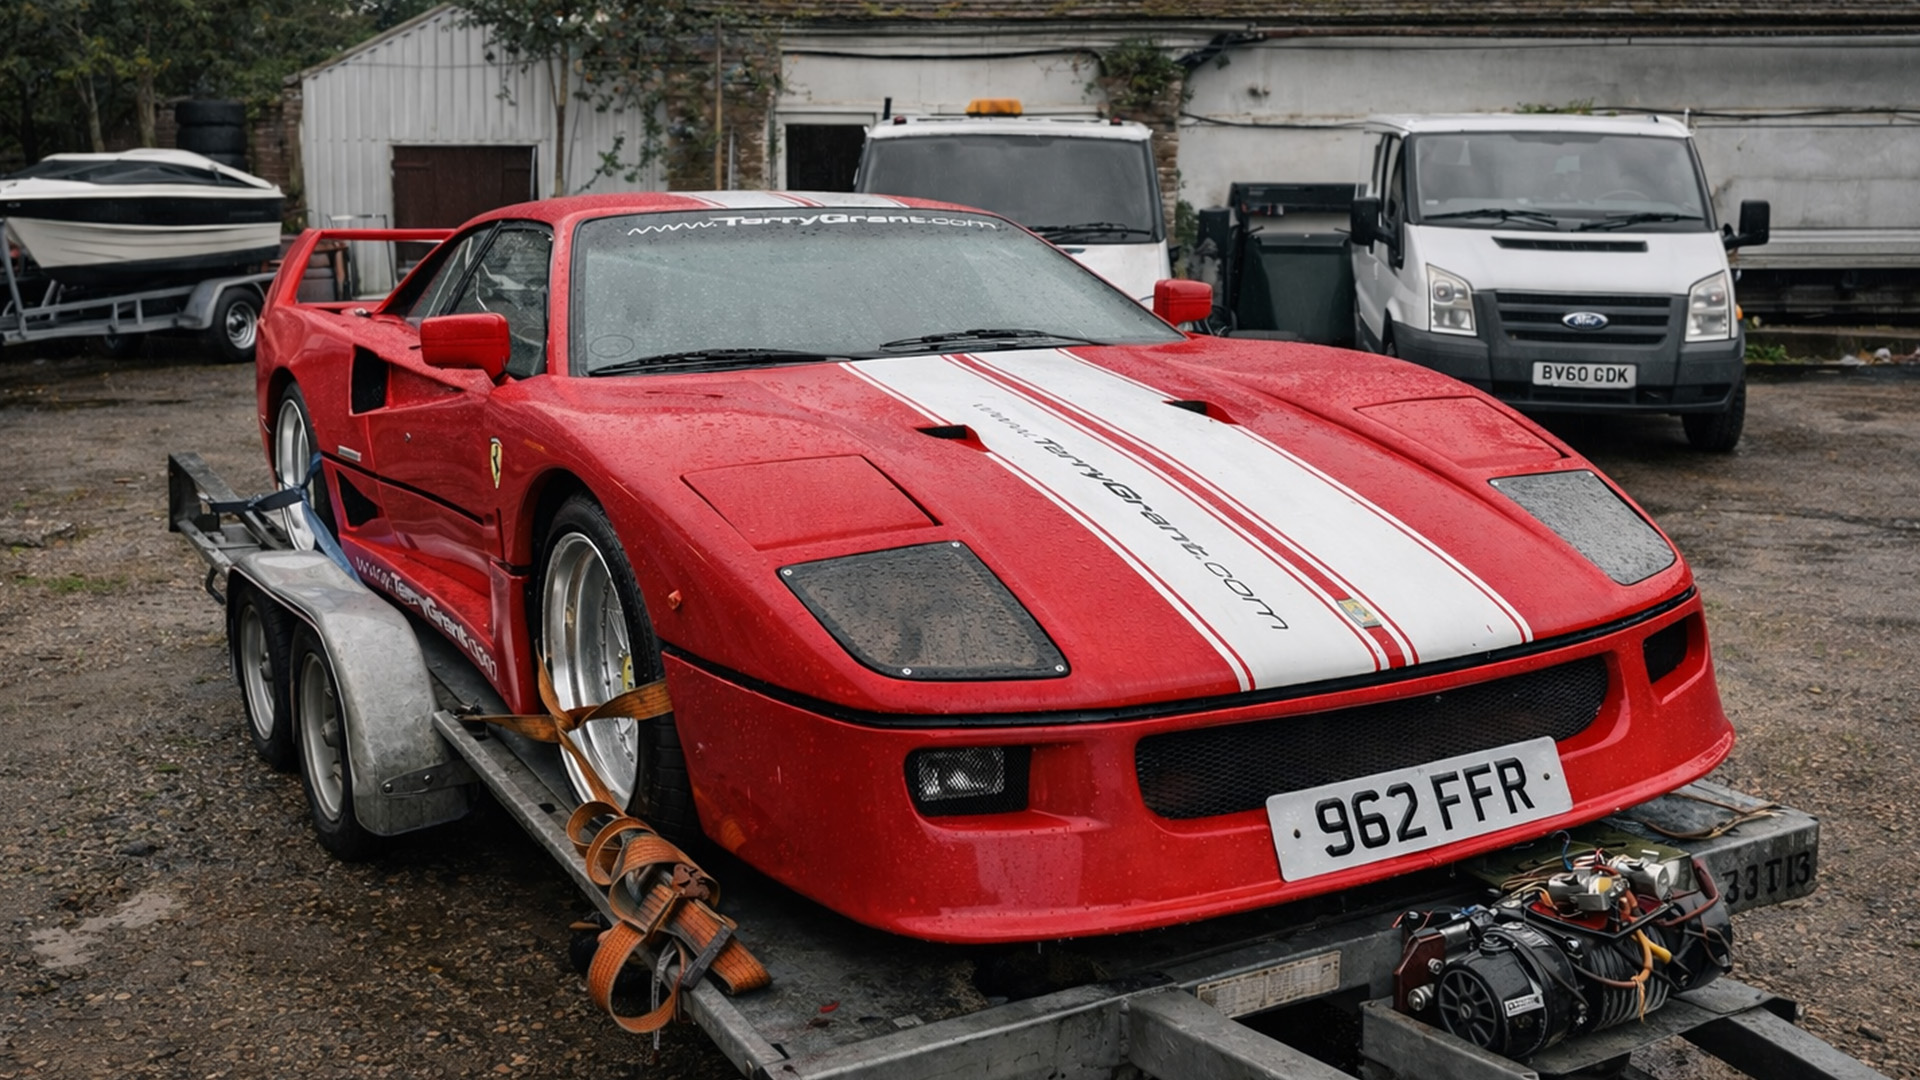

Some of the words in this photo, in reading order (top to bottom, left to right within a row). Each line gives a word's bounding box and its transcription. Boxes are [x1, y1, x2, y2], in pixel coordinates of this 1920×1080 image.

[627, 213, 997, 236] www.TerryGrant.com
[1542, 364, 1589, 383] BV60
[1594, 366, 1629, 384] GDK
[1314, 781, 1428, 858] 962
[1429, 756, 1536, 831] FFR
